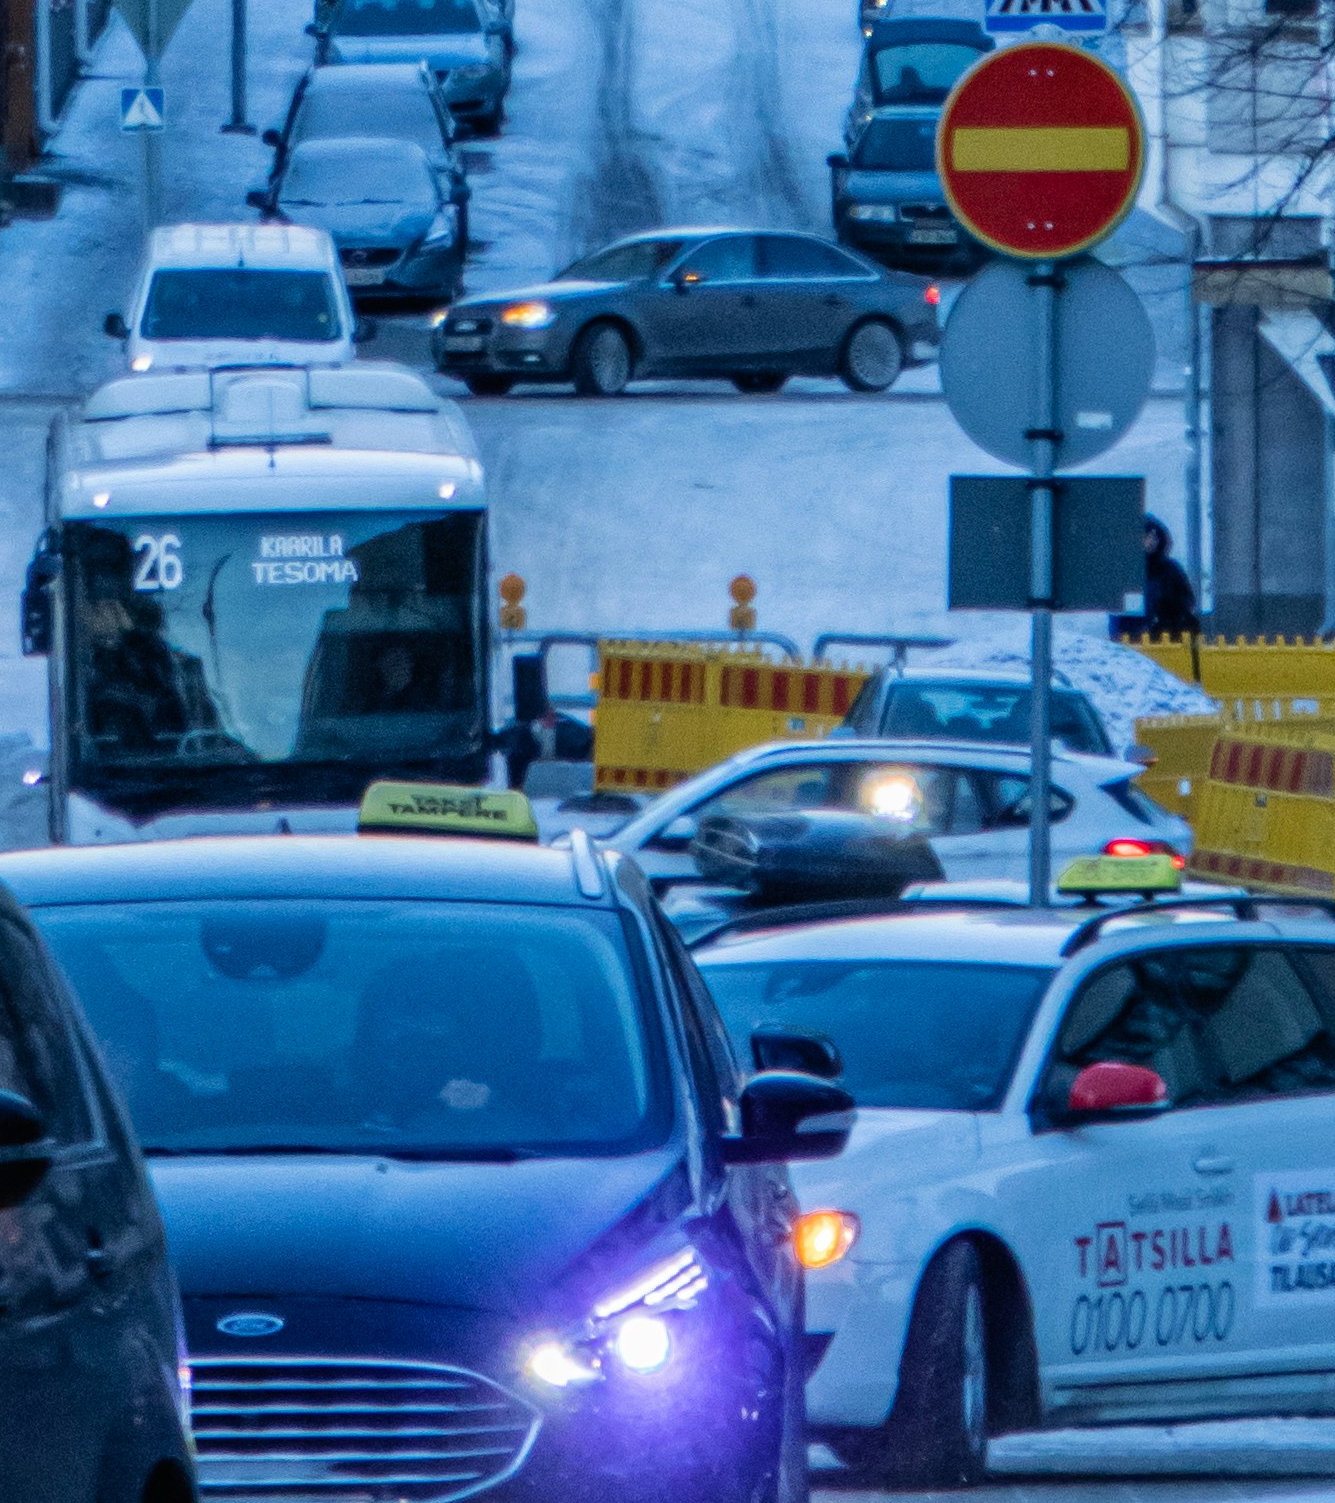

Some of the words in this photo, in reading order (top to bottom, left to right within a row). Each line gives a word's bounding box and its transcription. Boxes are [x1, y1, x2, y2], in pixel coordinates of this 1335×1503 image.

[133, 533, 184, 591] 26
[259, 534, 344, 558] KAARILA
[251, 561, 359, 585] TESOMA
[1074, 1221, 1235, 1285] TATSILLA
[1070, 1289, 1147, 1356] 0100
[1155, 1280, 1237, 1347] 0700
